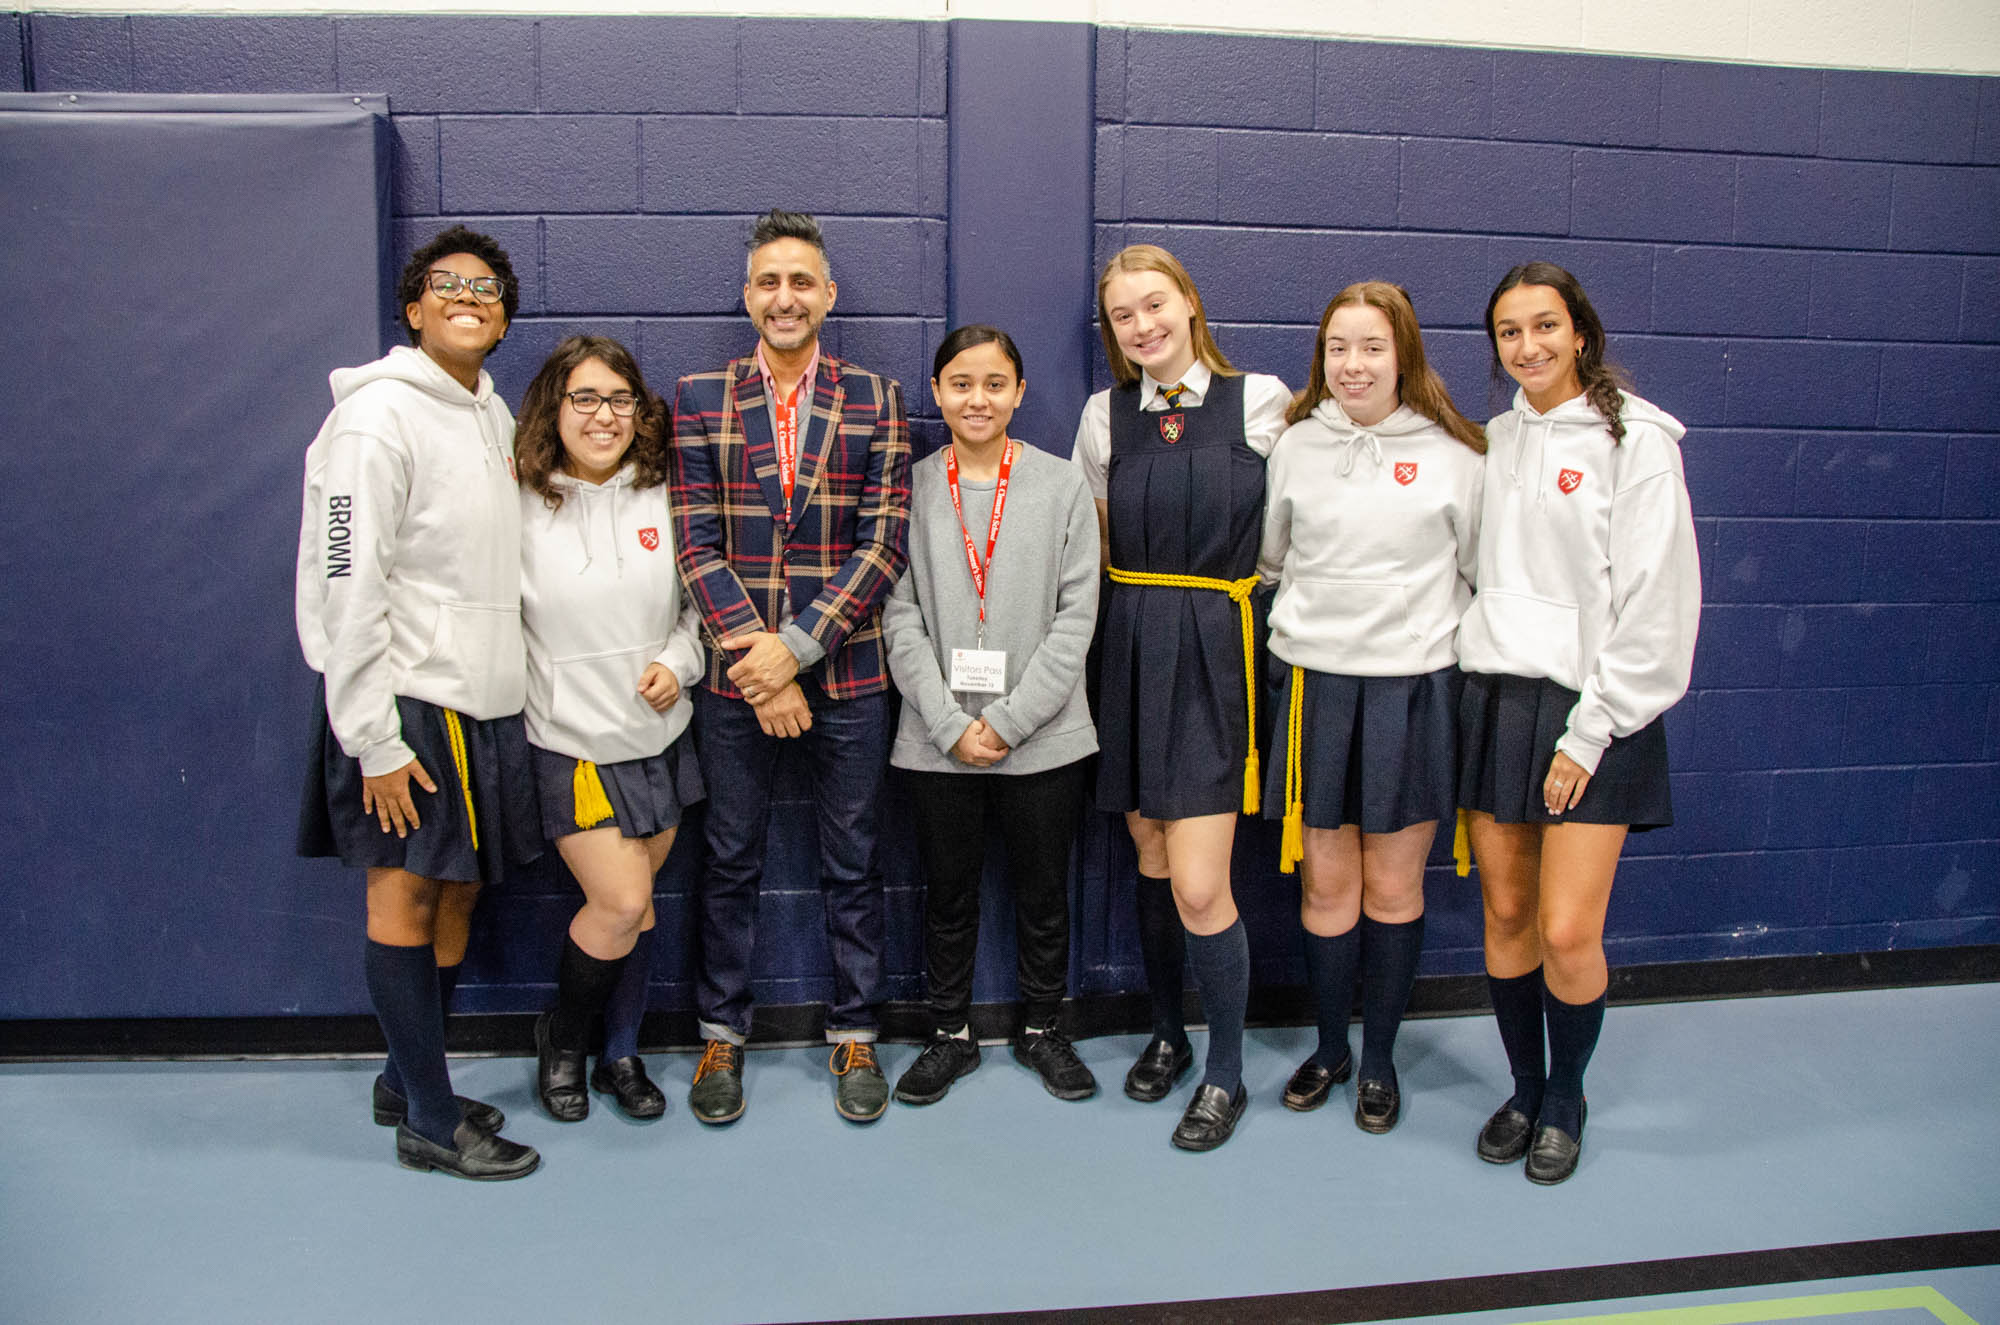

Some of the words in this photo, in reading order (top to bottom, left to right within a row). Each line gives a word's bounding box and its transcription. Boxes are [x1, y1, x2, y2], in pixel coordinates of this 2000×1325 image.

[779, 430, 790, 462] Clement's
[781, 463, 791, 485] School
[993, 488, 1005, 519] Clement's
[327, 495, 352, 579] BROWN
[990, 519, 1000, 541] School
[967, 543, 980, 574] Clement's
[953, 664, 982, 673] Visitors
[983, 666, 1002, 675] Pass
